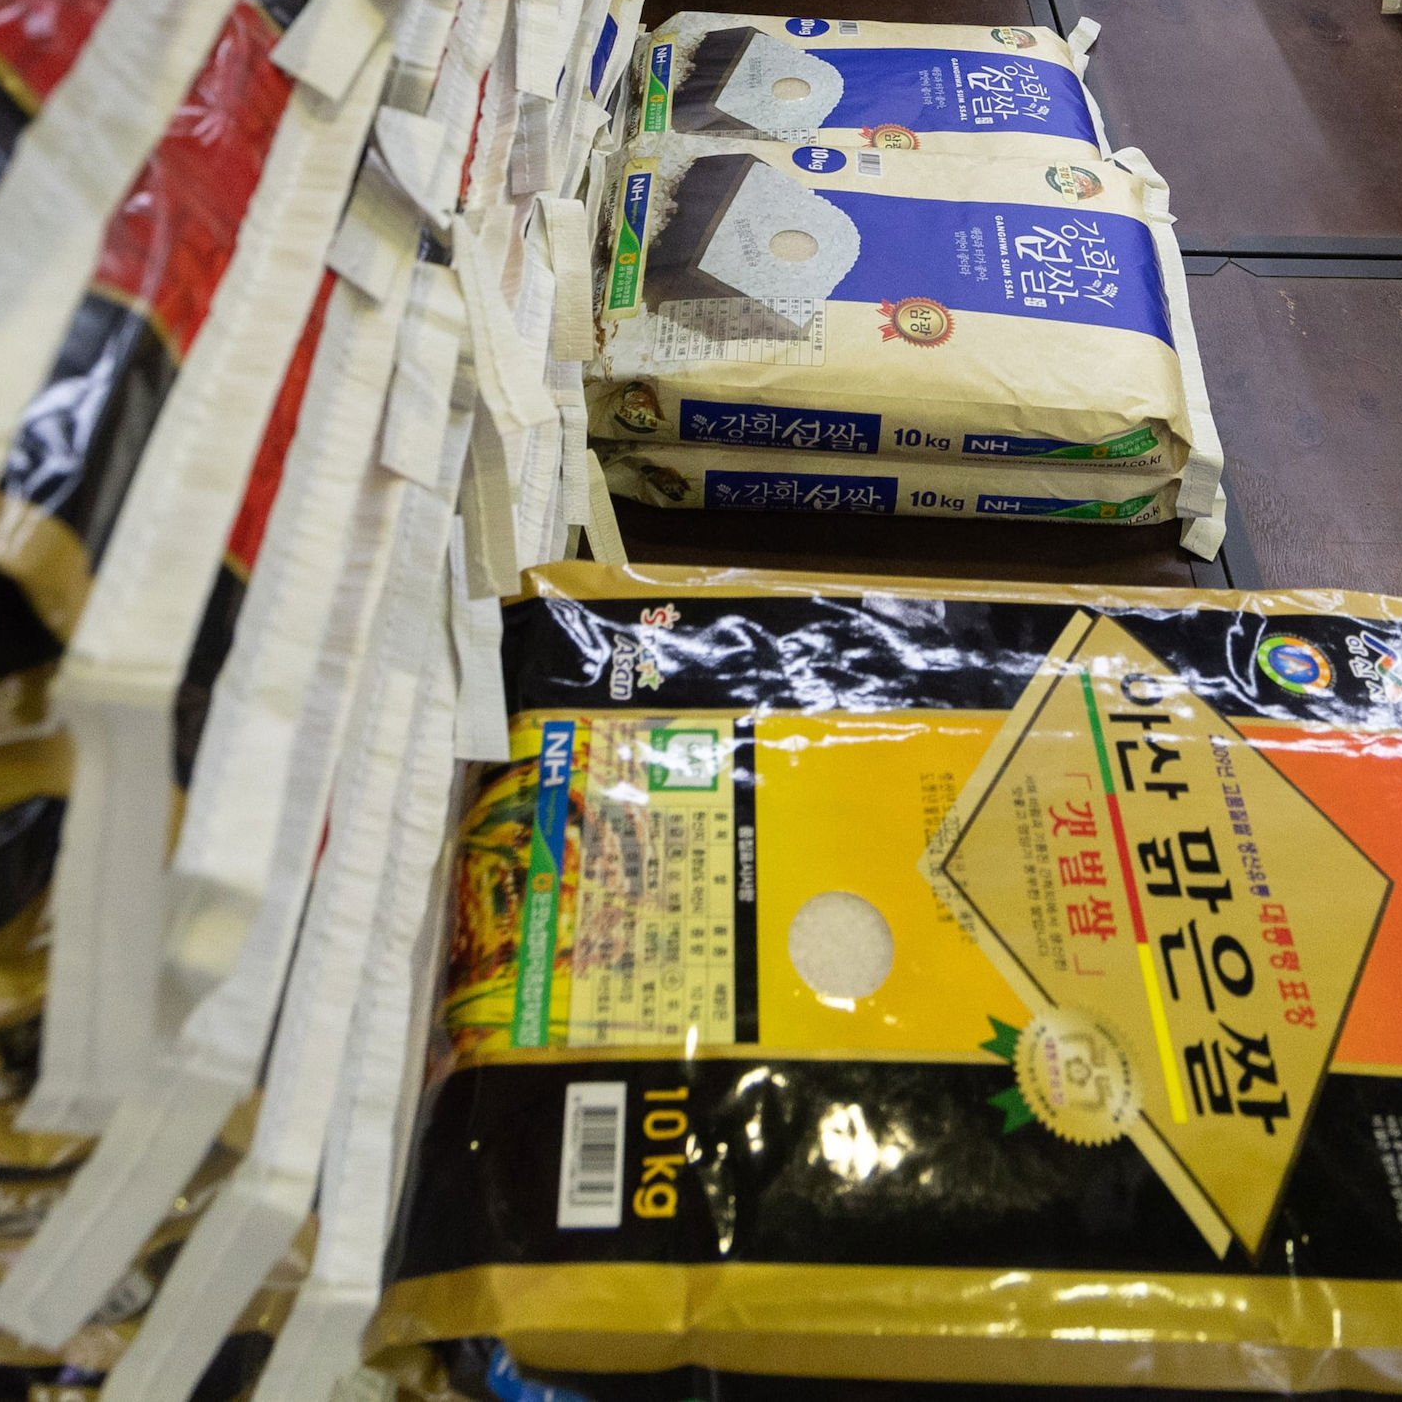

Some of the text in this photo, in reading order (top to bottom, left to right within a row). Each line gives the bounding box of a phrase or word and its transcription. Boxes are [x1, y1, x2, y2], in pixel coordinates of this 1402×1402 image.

[655, 45, 667, 65] NH
[798, 17, 816, 38] 10kg
[951, 57, 969, 122] GANGHWA SUM SSAL
[968, 66, 1019, 121] 섬쌀
[1002, 61, 1051, 103] 강화
[807, 147, 831, 171] 10kg
[629, 177, 647, 202] NH
[994, 214, 1015, 300] GANGHWA SUM SSAL
[1014, 226, 1079, 305] 섬쌀
[1060, 218, 1120, 280] 강화
[718, 411, 864, 453] 강화섬쌀
[971, 436, 1008, 453] NH
[743, 480, 883, 513] 강화섬쌀
[983, 498, 1021, 512] NH
[610, 632, 634, 702] Asan
[543, 731, 570, 787] NH
[1108, 672, 1291, 1137] 아산 맑은쌀
[1251, 900, 1305, 978] 대통령
[1272, 971, 1322, 1036] 표창
[632, 1085, 689, 1220] 10kg
